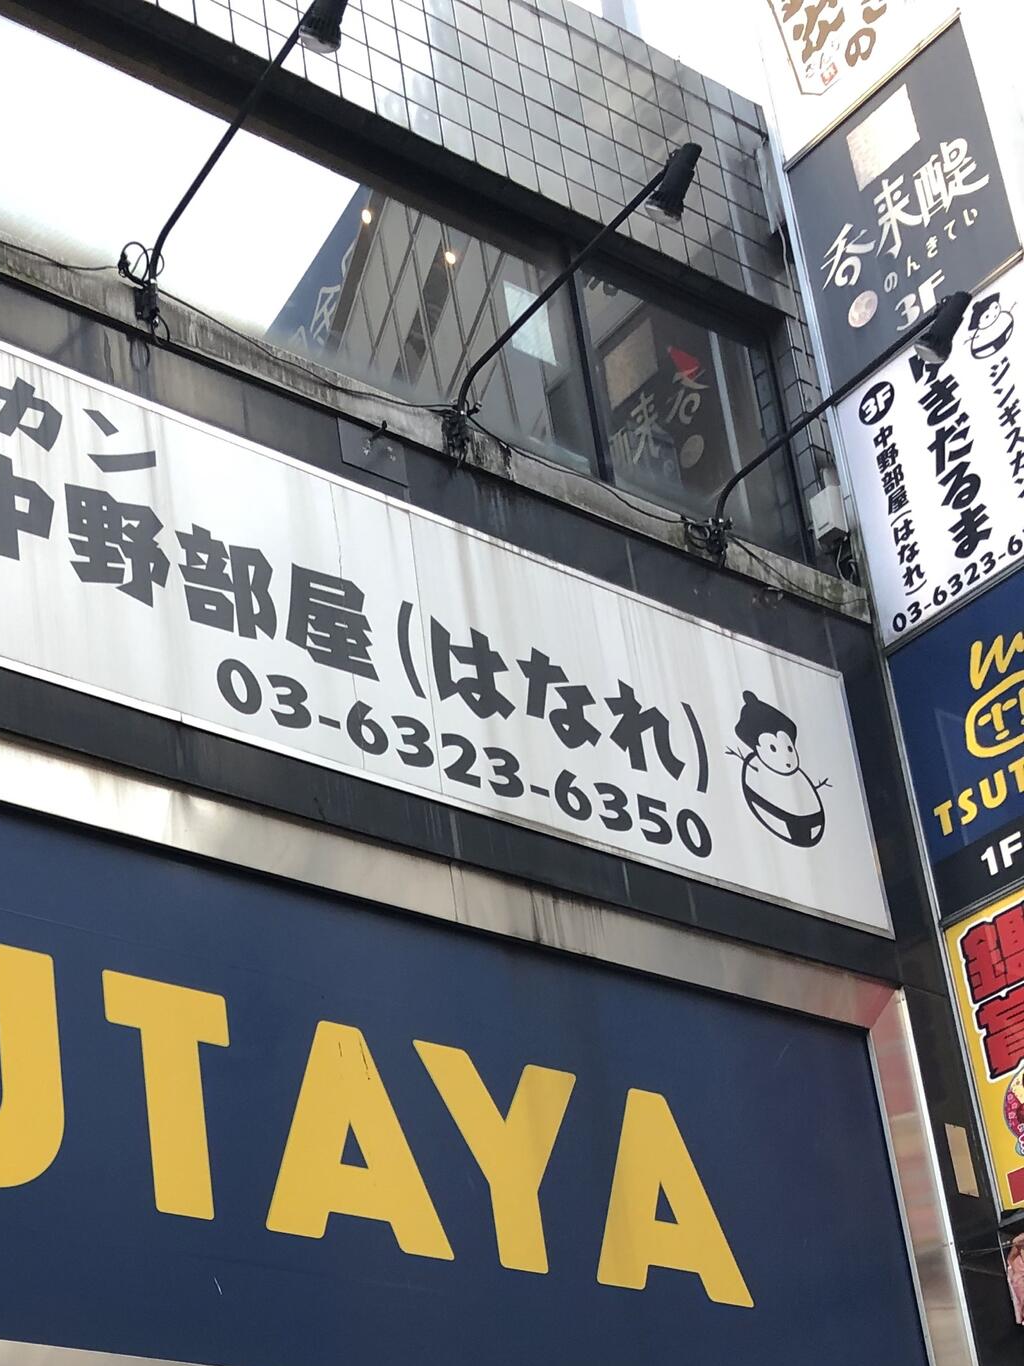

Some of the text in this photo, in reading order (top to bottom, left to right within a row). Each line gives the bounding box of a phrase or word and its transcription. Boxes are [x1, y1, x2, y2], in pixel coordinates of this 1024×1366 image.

[883, 208, 978, 293] のんきてい
[895, 269, 945, 331] 3F
[861, 383, 893, 422] 3F
[873, 425, 927, 596] 中野部屋(はなれ)
[216, 658, 713, 858] 03-6323-6350
[980, 831, 1023, 876] 1F
